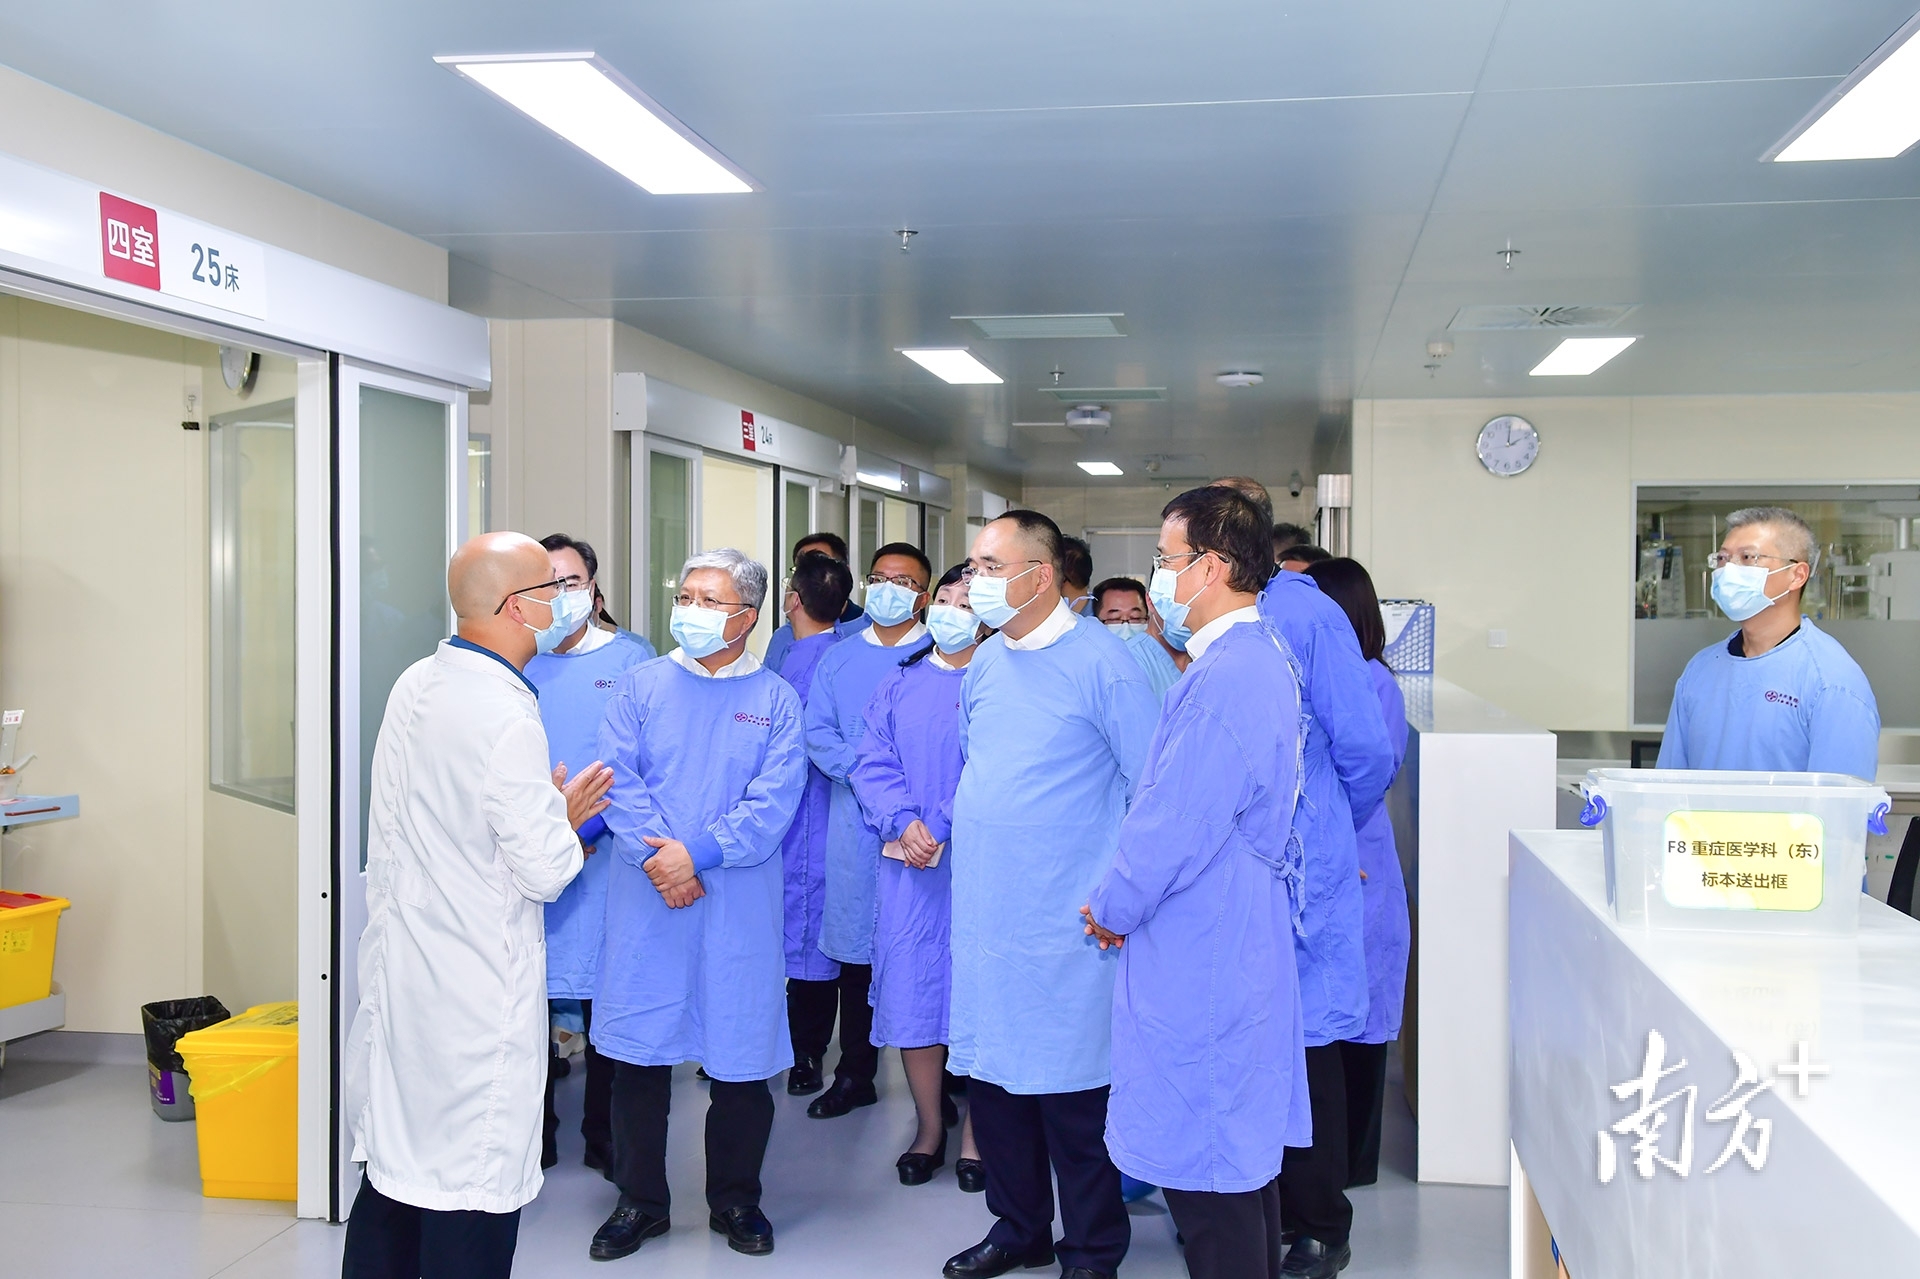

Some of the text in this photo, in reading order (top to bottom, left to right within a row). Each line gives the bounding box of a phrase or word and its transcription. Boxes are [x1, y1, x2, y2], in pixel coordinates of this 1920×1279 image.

[107, 217, 156, 268] 四室
[191, 242, 240, 293] 25床
[1668, 840, 1687, 853] F8
[1701, 871, 1789, 889] 标本送出框
